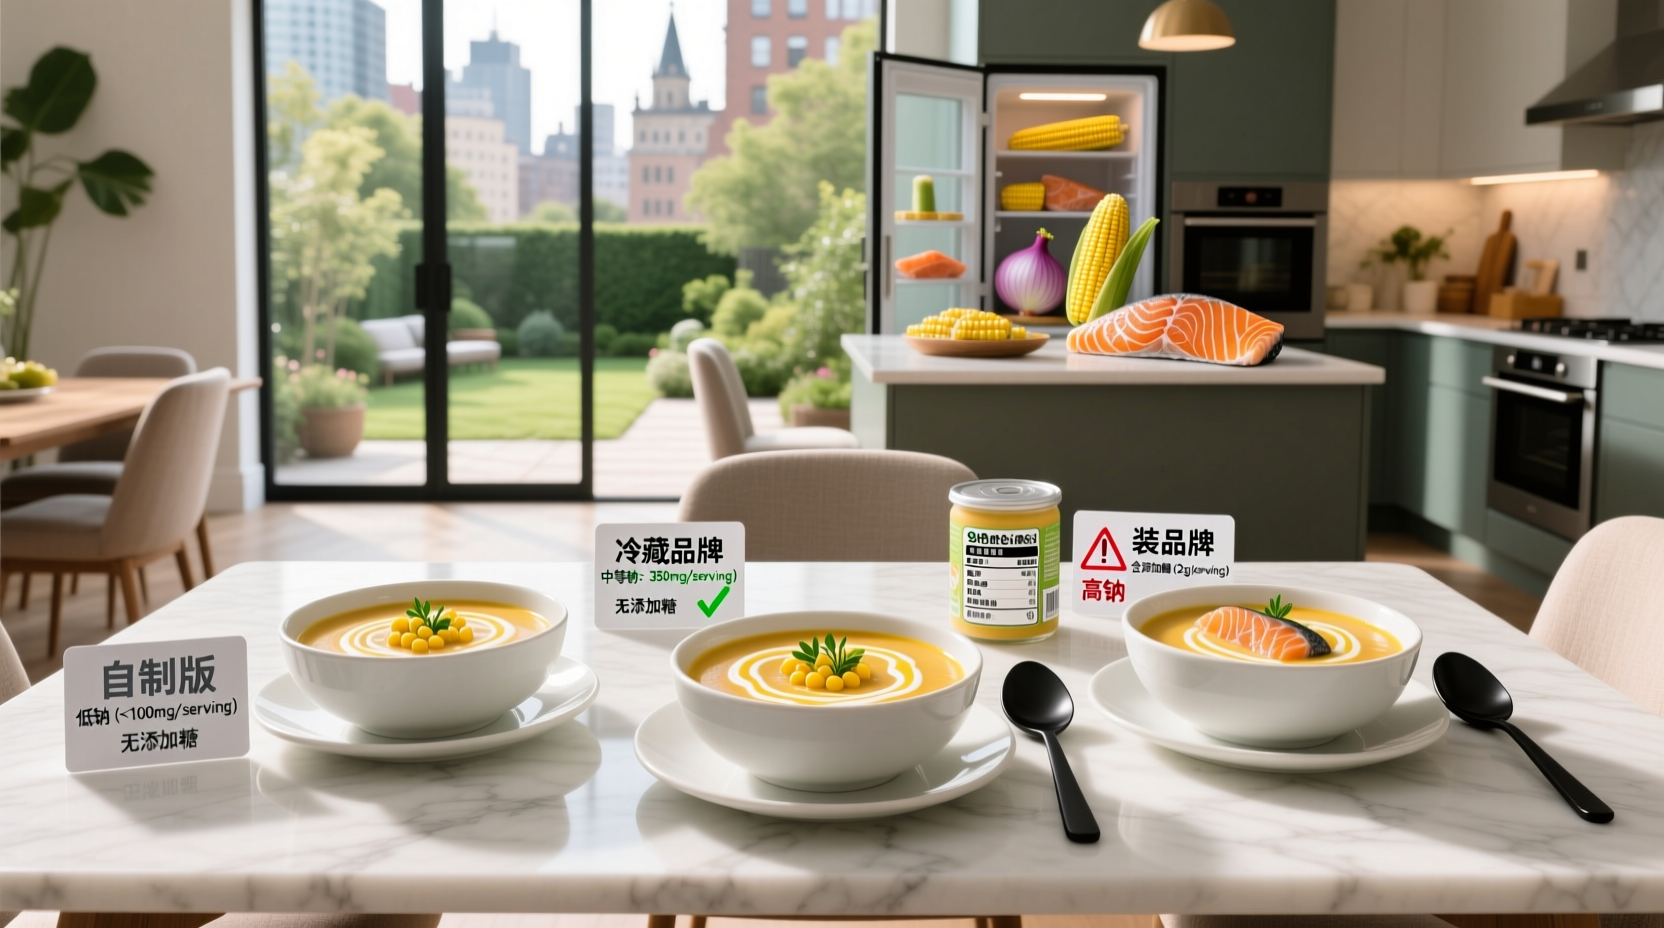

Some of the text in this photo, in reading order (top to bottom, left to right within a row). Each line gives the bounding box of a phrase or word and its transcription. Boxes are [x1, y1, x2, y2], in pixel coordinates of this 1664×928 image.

[615, 536, 724, 565] 冷藏品牌
[1132, 526, 1214, 557] 装品牌
[1082, 578, 1126, 603] 高钠
[615, 597, 678, 615] 无添加糖
[103, 654, 217, 700] 自制版
[120, 727, 199, 753] 无添加糖
